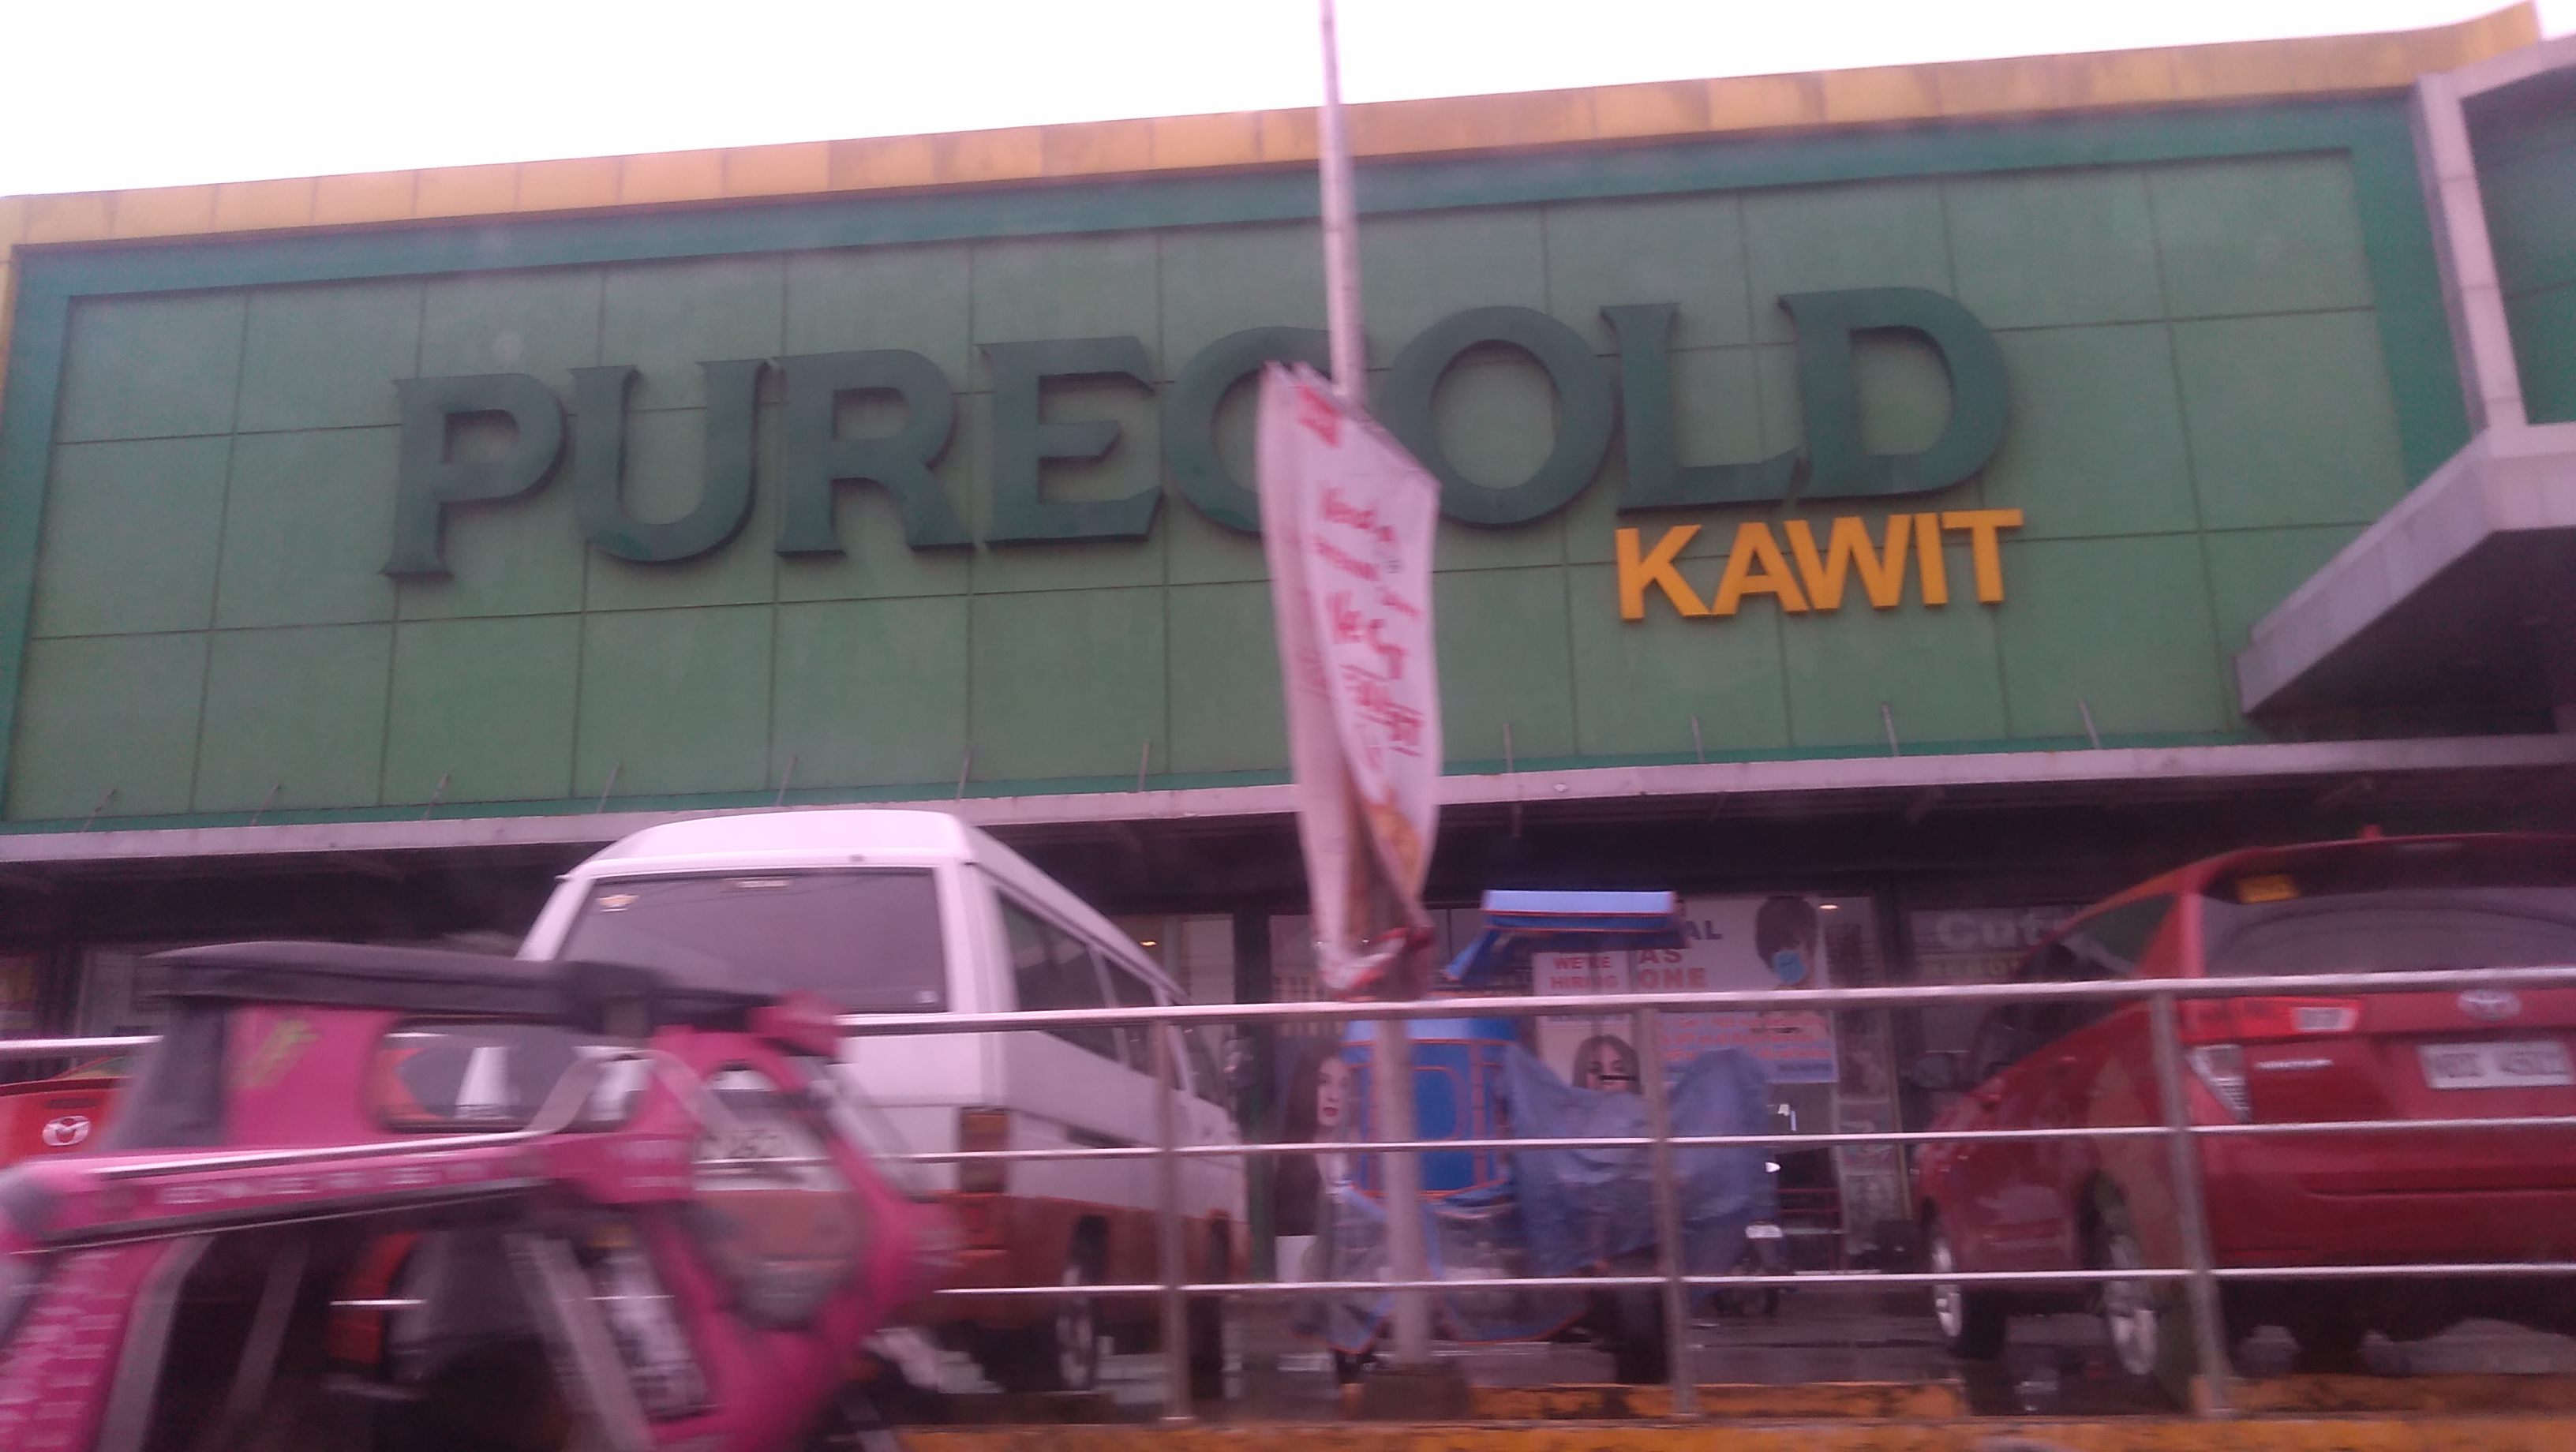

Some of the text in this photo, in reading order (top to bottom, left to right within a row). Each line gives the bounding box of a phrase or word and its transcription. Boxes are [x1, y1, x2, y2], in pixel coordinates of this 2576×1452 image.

[1616, 508, 2024, 620] KAWIT
[1637, 949, 1683, 965] AS
[1549, 975, 1619, 990] HIRING
[1637, 967, 1709, 990] ONE
